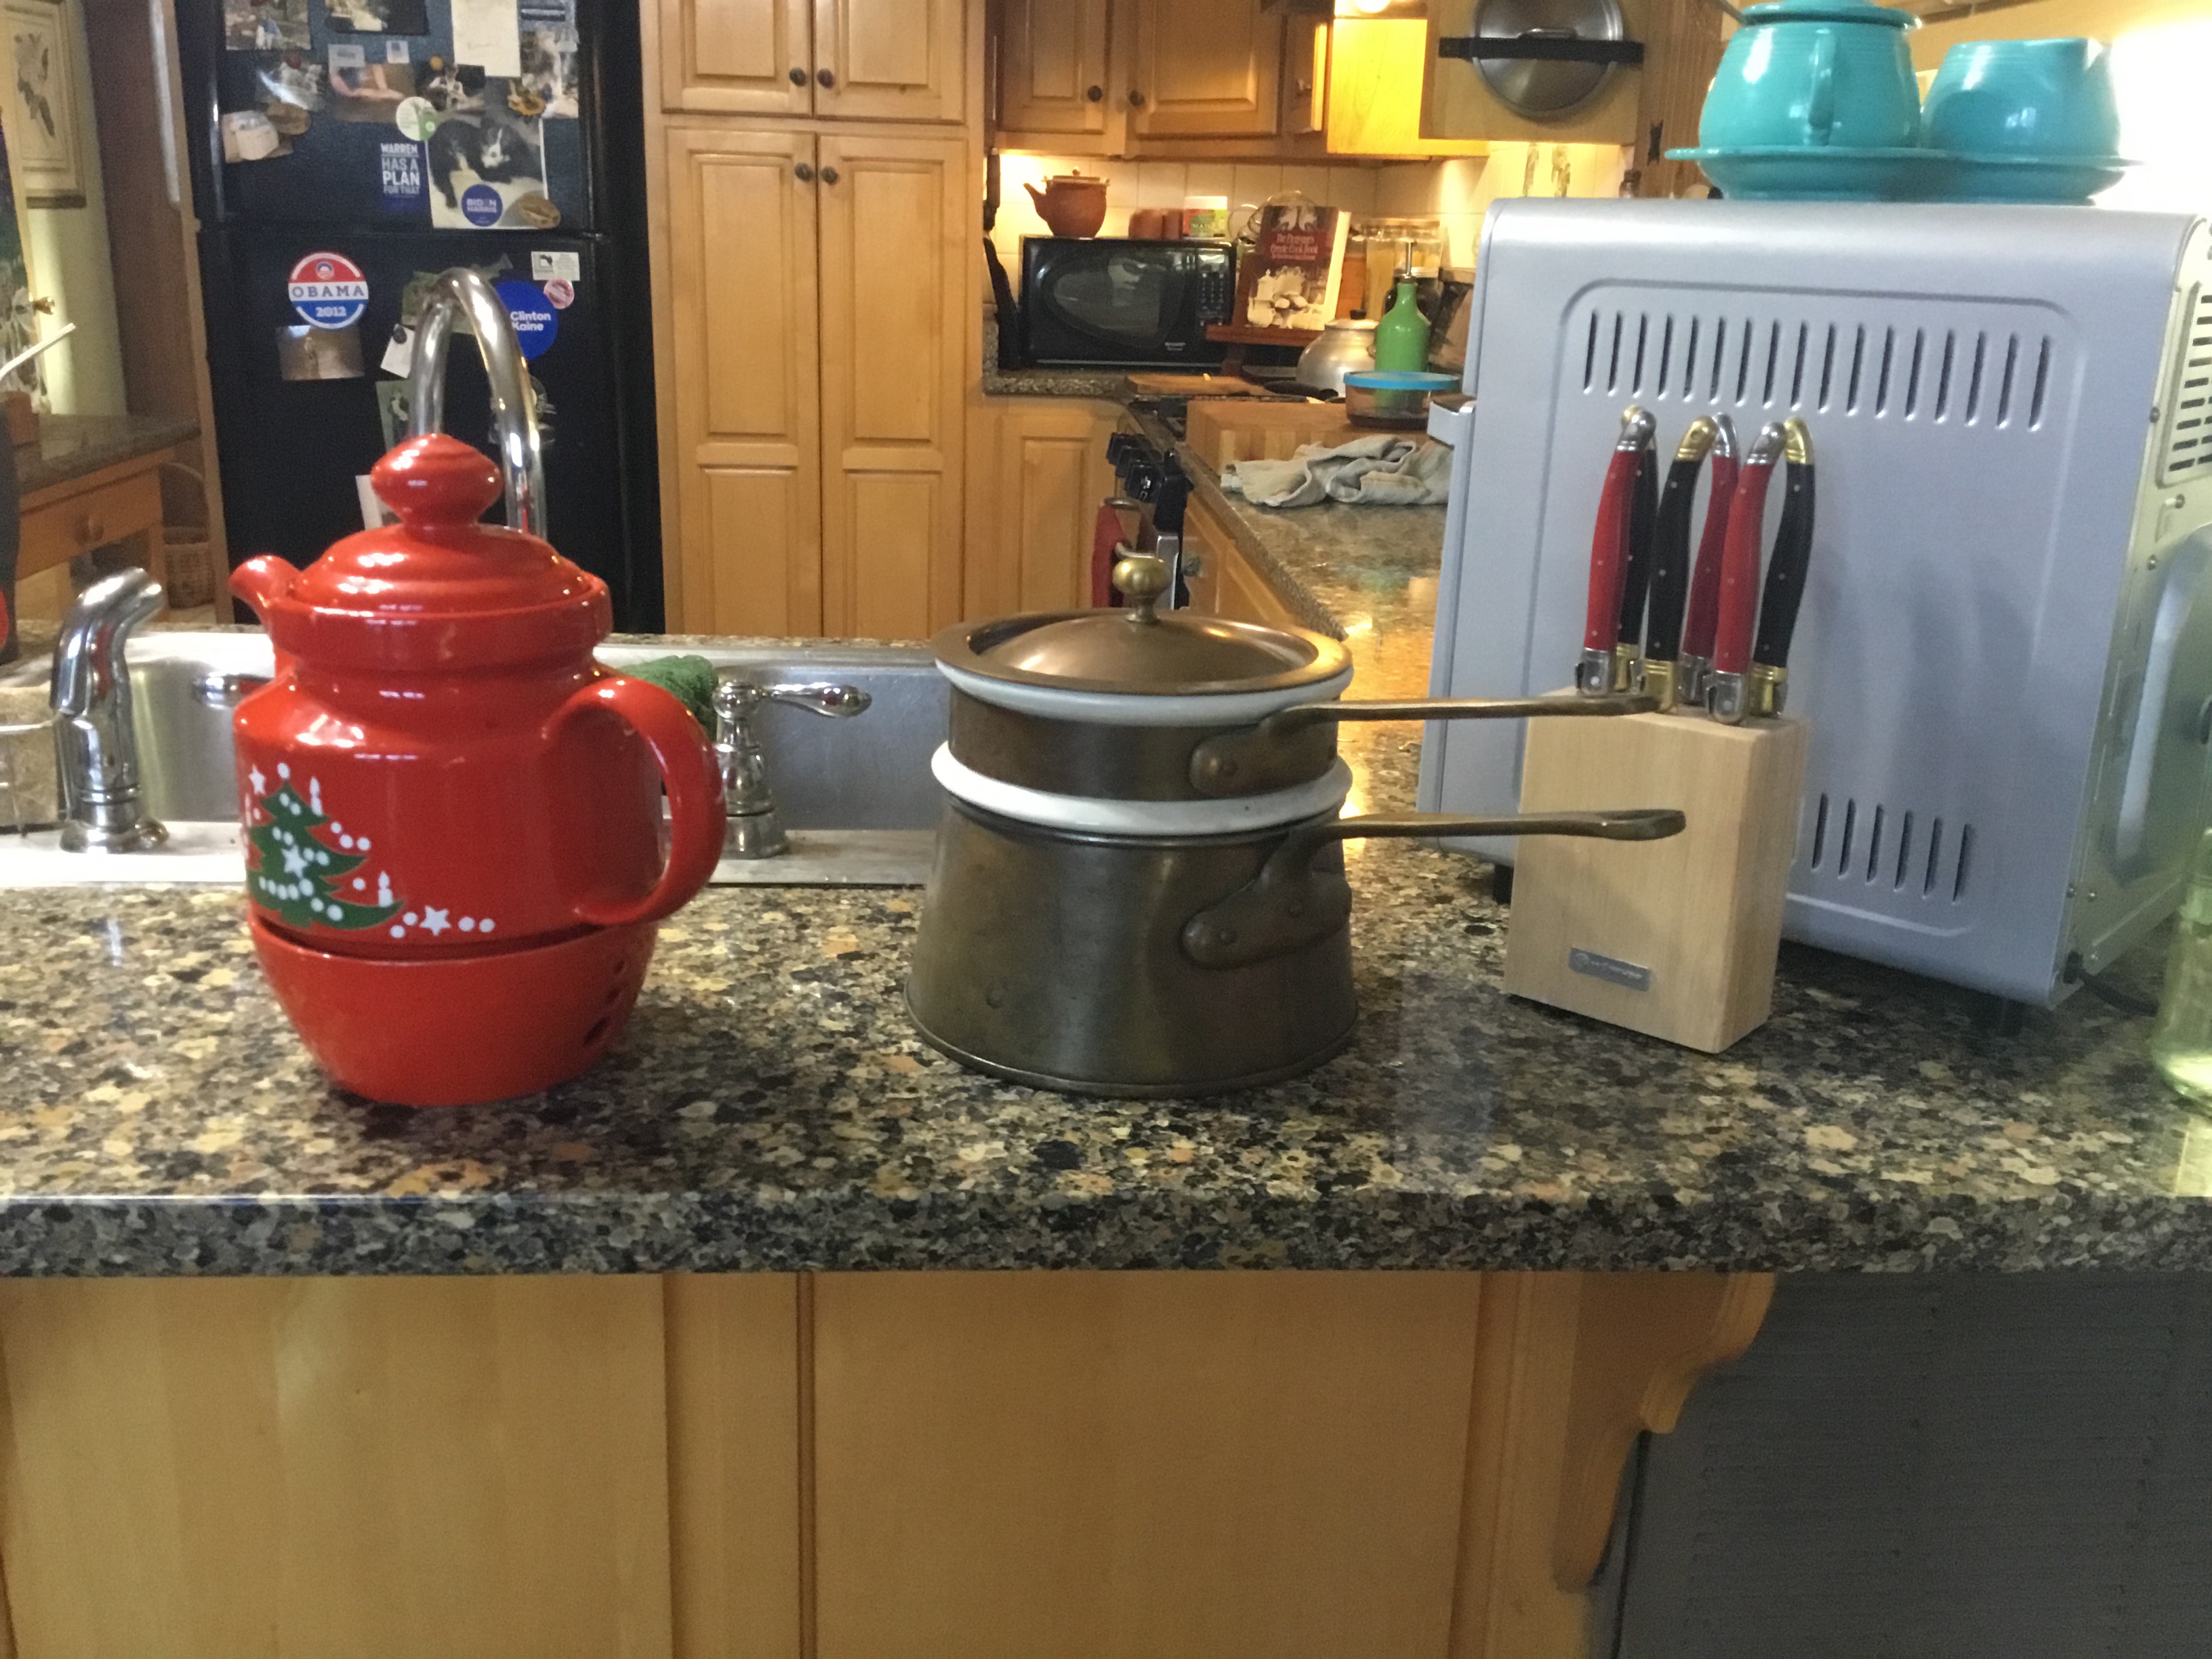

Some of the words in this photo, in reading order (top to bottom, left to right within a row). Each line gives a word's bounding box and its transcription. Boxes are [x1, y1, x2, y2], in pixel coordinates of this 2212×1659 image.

[380, 142, 418, 154] WARREN
[382, 158, 407, 171] HAS
[410, 158, 419, 171] A
[382, 171, 420, 186] PLAN
[292, 285, 365, 298] OBAMA
[315, 306, 347, 317] 2012
[510, 311, 551, 321] Clinton
[512, 321, 544, 331] Kaine
